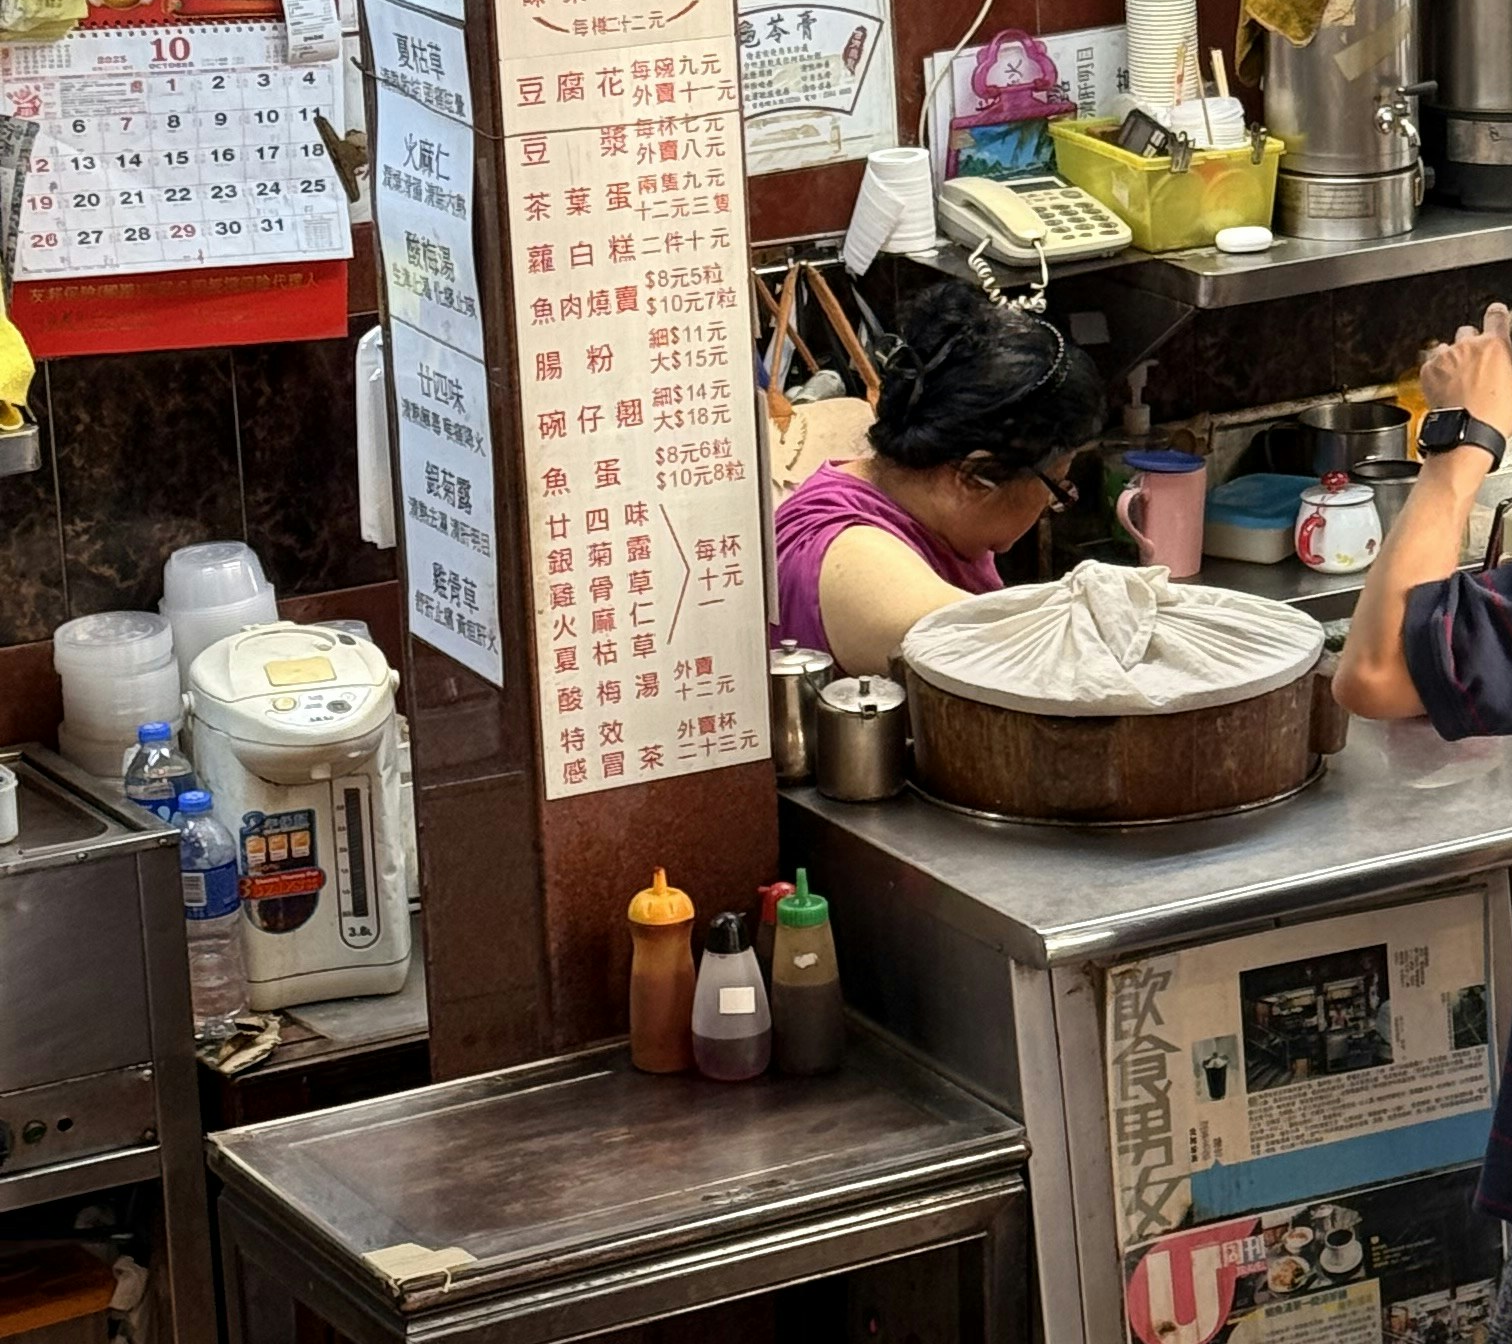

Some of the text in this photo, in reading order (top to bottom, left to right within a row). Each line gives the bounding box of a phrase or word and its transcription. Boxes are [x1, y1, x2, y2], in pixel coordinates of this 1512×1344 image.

[150, 37, 191, 62] 10
[166, 71, 316, 92] 1 2 3 4
[516, 67, 624, 107] 豆腐花
[633, 80, 736, 107] 外賣十一元
[72, 119, 86, 133] 6
[120, 117, 132, 131] 7
[167, 115, 181, 129] 8
[214, 112, 227, 126] 9
[254, 109, 280, 124] 10
[70, 157, 97, 172] 13
[116, 154, 142, 169] 14
[164, 152, 190, 166] 15
[210, 148, 236, 163] 16
[256, 146, 281, 161] 17
[300, 143, 325, 158] 18
[521, 125, 629, 167] 豆漿
[637, 141, 726, 165] 外賣八元
[27, 178, 326, 211] 19 20 21 22 23 24 25
[524, 182, 632, 222] 茶葉蛋
[30, 217, 285, 249] 26 27 28 29 30 31
[641, 227, 731, 255] 二件十元
[527, 235, 636, 276] 蘿白糕
[644, 264, 724, 290] $8元5粒
[530, 284, 639, 326] 魚肉燒賣
[646, 288, 737, 317] $10元7粒
[648, 320, 728, 348] 細$11元
[535, 343, 613, 383] 腸粉
[650, 345, 729, 374] 大$15元
[652, 379, 732, 408] 細$14元
[653, 404, 732, 433] 大$18元
[654, 438, 733, 467] $8元6粒
[541, 458, 622, 498] 魚蛋
[656, 459, 746, 491] $10元8粒
[545, 501, 649, 540] 廿四味
[547, 534, 651, 575] 銀菊露
[549, 569, 653, 610] 雞骨草
[552, 601, 655, 641] 火麻仁
[554, 632, 657, 674] 夏枯草
[557, 671, 660, 715] 酸梅湯
[675, 675, 736, 701] 十二元
[1113, 964, 1191, 1240] 飲食男女
